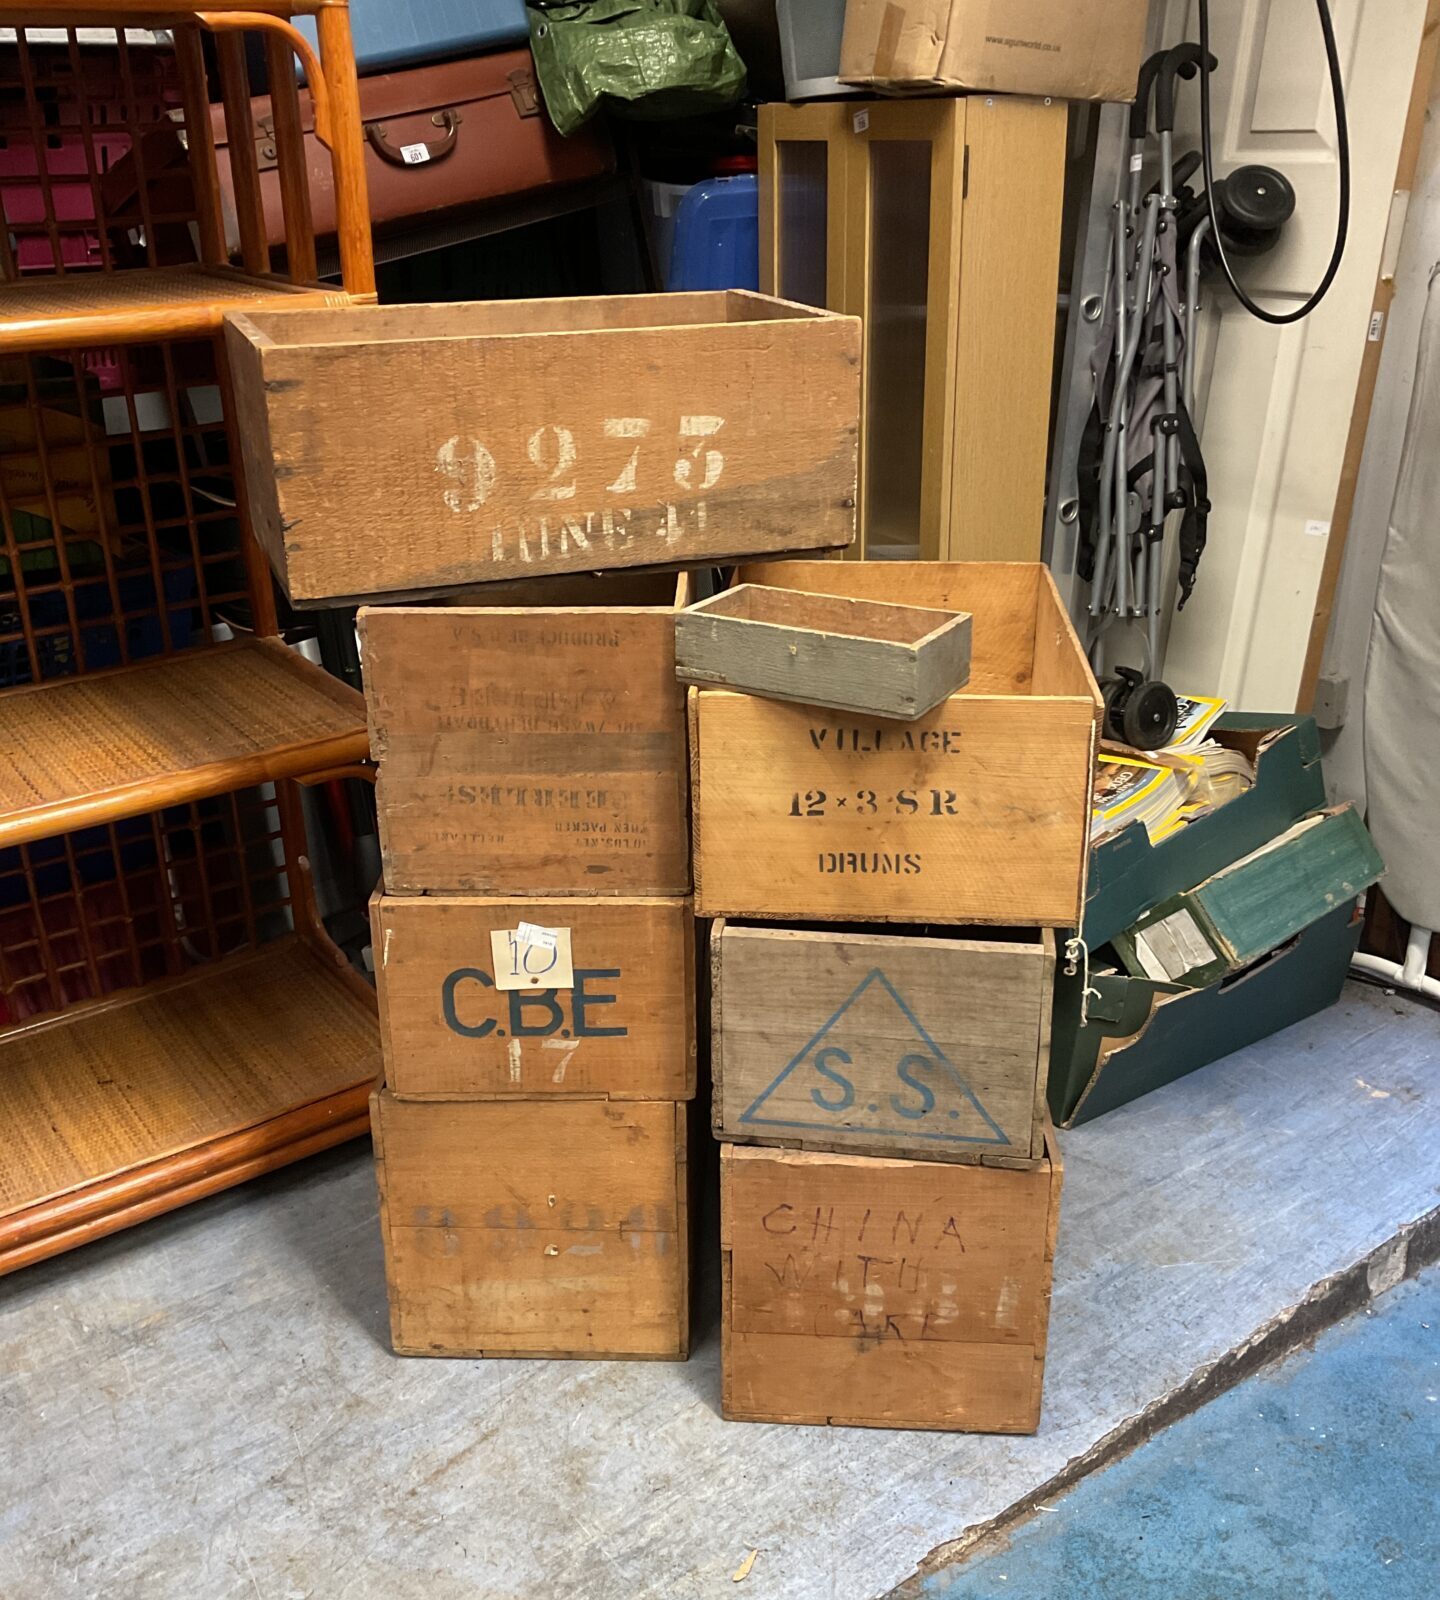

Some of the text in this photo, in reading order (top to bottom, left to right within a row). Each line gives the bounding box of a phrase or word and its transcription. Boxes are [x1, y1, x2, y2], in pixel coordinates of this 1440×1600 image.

[808, 728, 962, 754] VILLAGE
[818, 852, 922, 874] DRUMS
[810, 1046, 961, 1121] S.S.
[762, 1202, 966, 1254] CHINA
[764, 1252, 926, 1294] WITH
